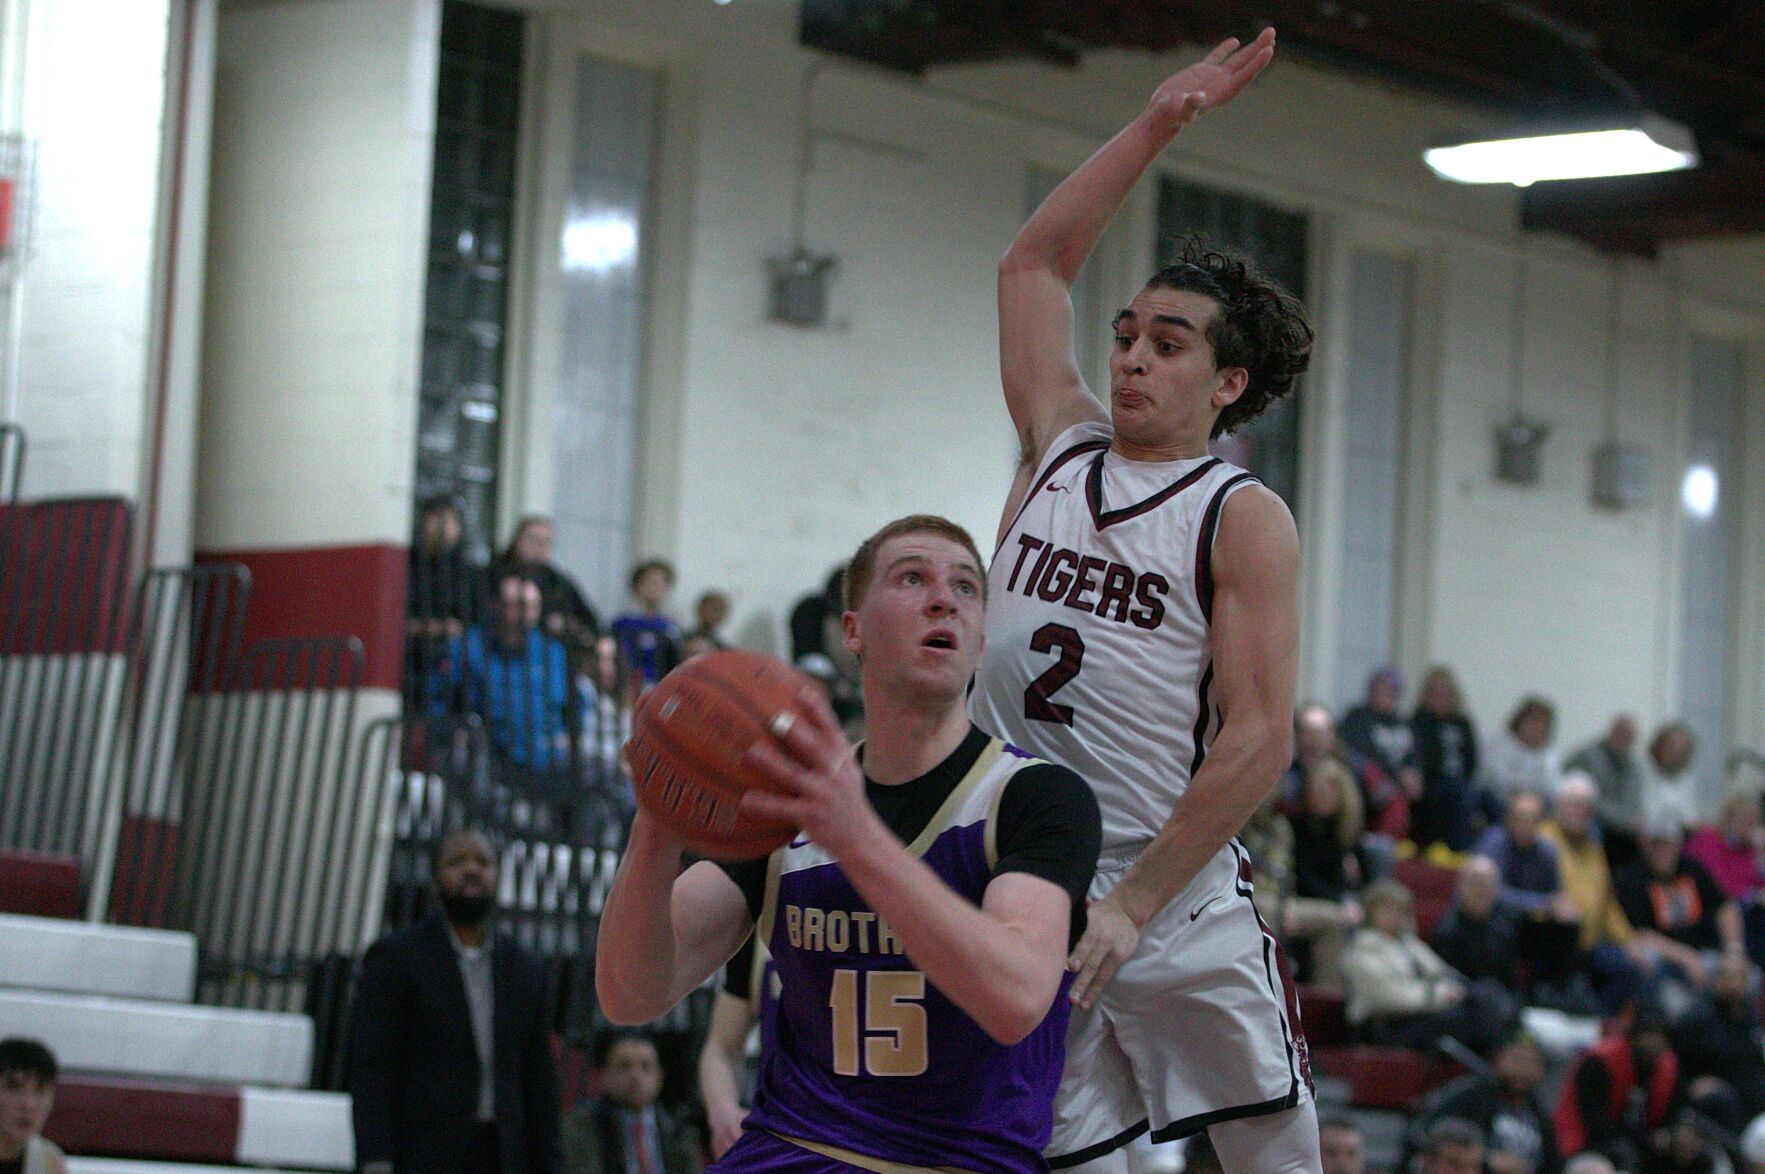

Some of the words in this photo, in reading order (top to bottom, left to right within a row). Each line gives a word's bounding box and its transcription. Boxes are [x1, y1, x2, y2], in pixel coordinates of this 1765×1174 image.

[1007, 533, 1169, 630] TIGERS
[1024, 622, 1085, 728] 2
[786, 904, 904, 954] BROTH
[829, 969, 928, 1076] 15
